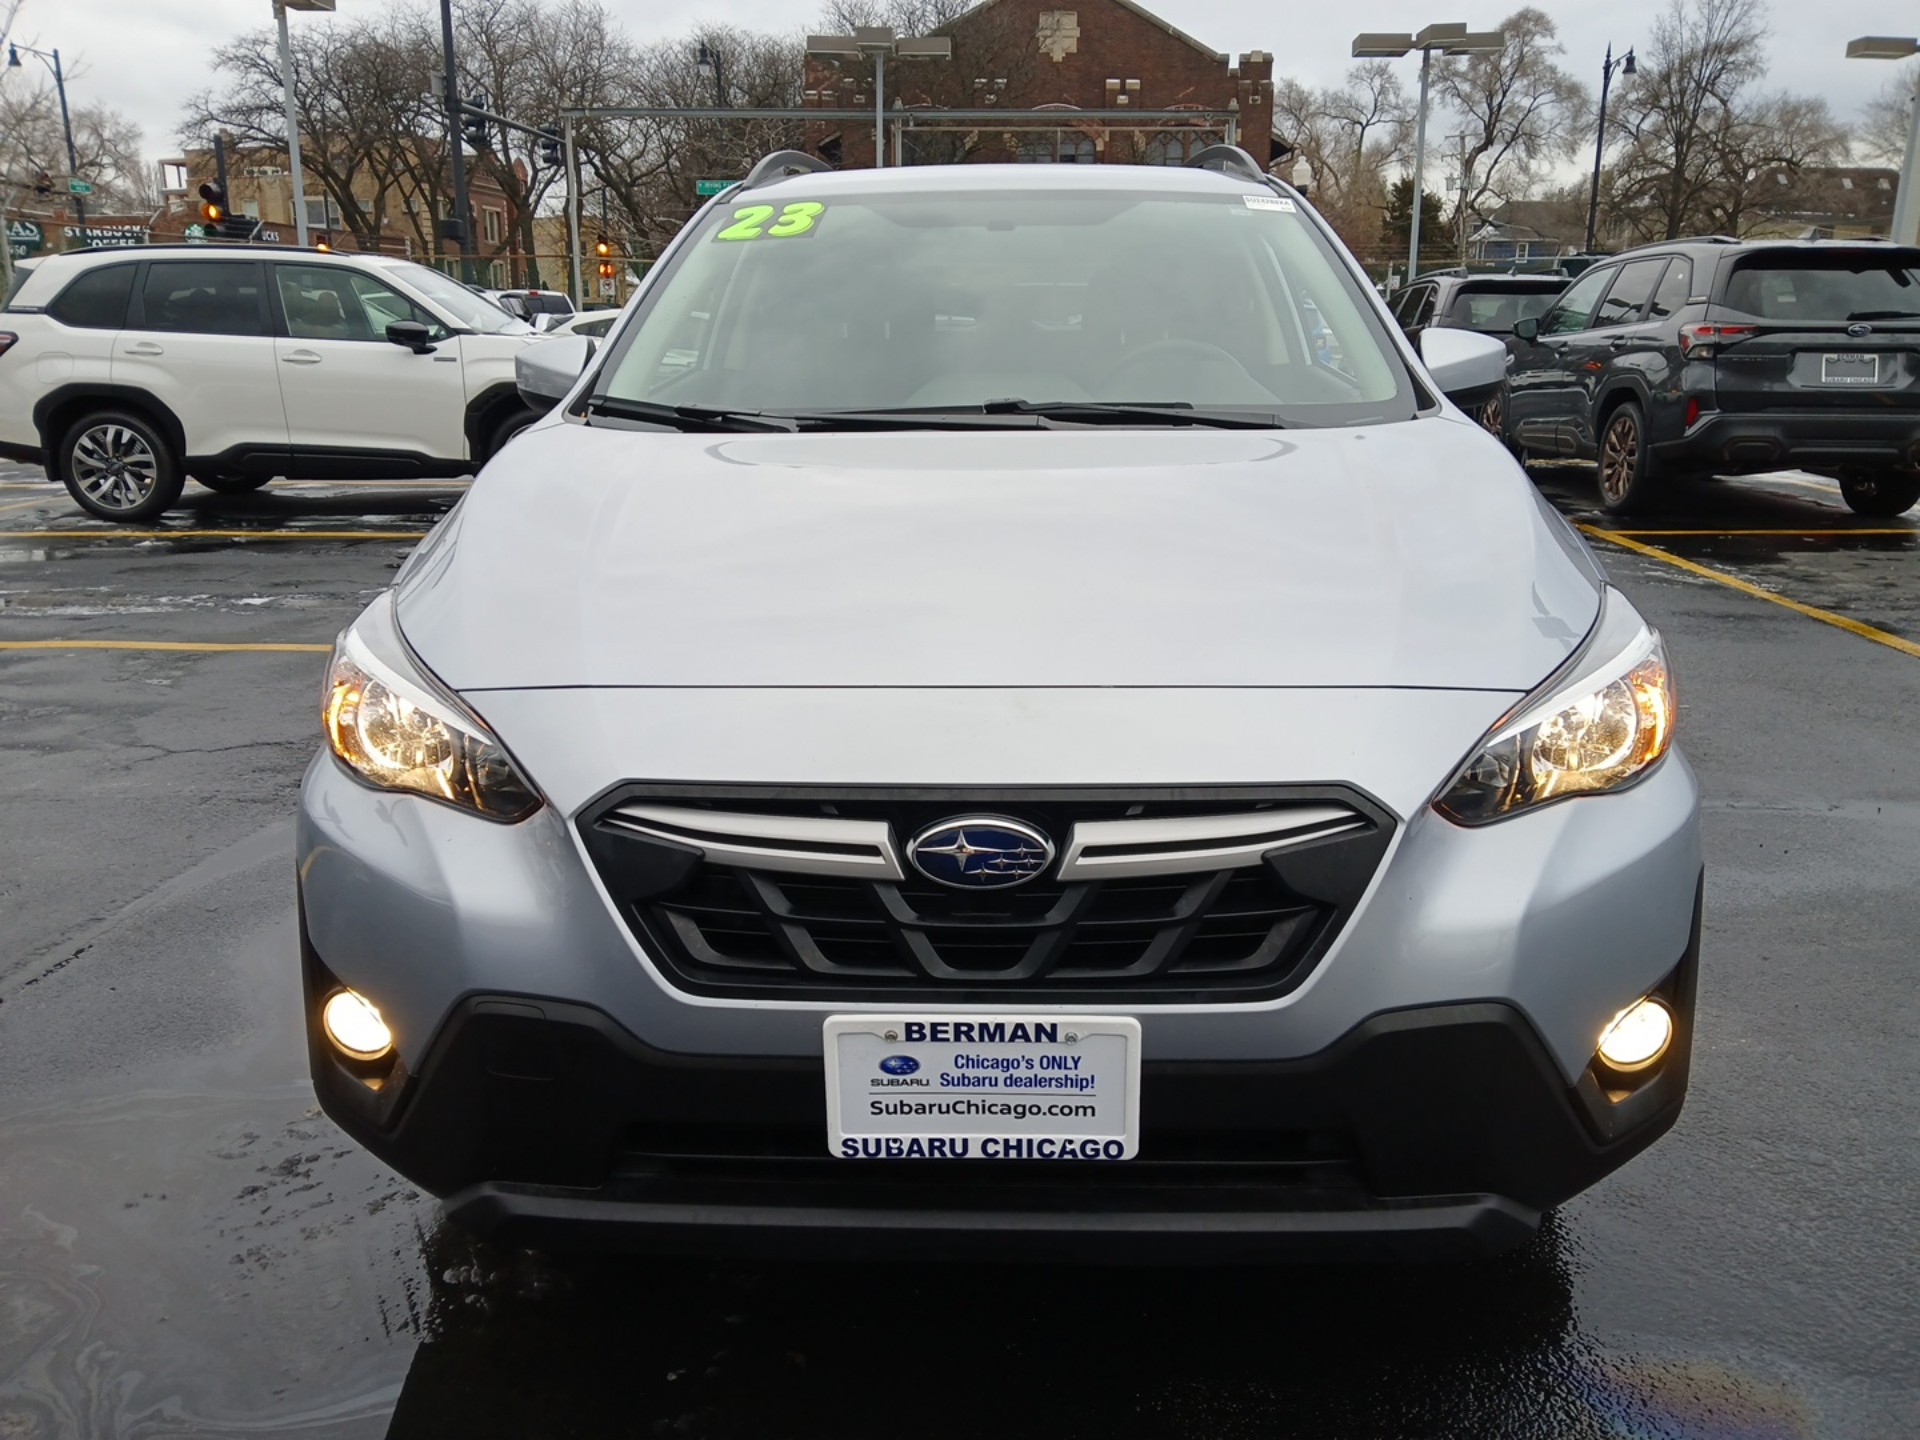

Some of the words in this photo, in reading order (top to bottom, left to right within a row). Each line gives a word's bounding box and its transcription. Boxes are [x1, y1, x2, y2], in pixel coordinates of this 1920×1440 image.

[717, 202, 825, 241] 23
[904, 1022, 1058, 1043] BERMAN
[954, 1054, 1034, 1072] Chicago's
[1039, 1055, 1082, 1070] ONLY
[870, 1078, 930, 1087] SUBARU
[939, 1072, 998, 1087] Subaru
[1003, 1073, 1095, 1092] dealership!
[870, 1100, 1096, 1119] SubaruChicago.com
[841, 1137, 969, 1158] SUBARU
[981, 1137, 1125, 1160] CHICAGO
